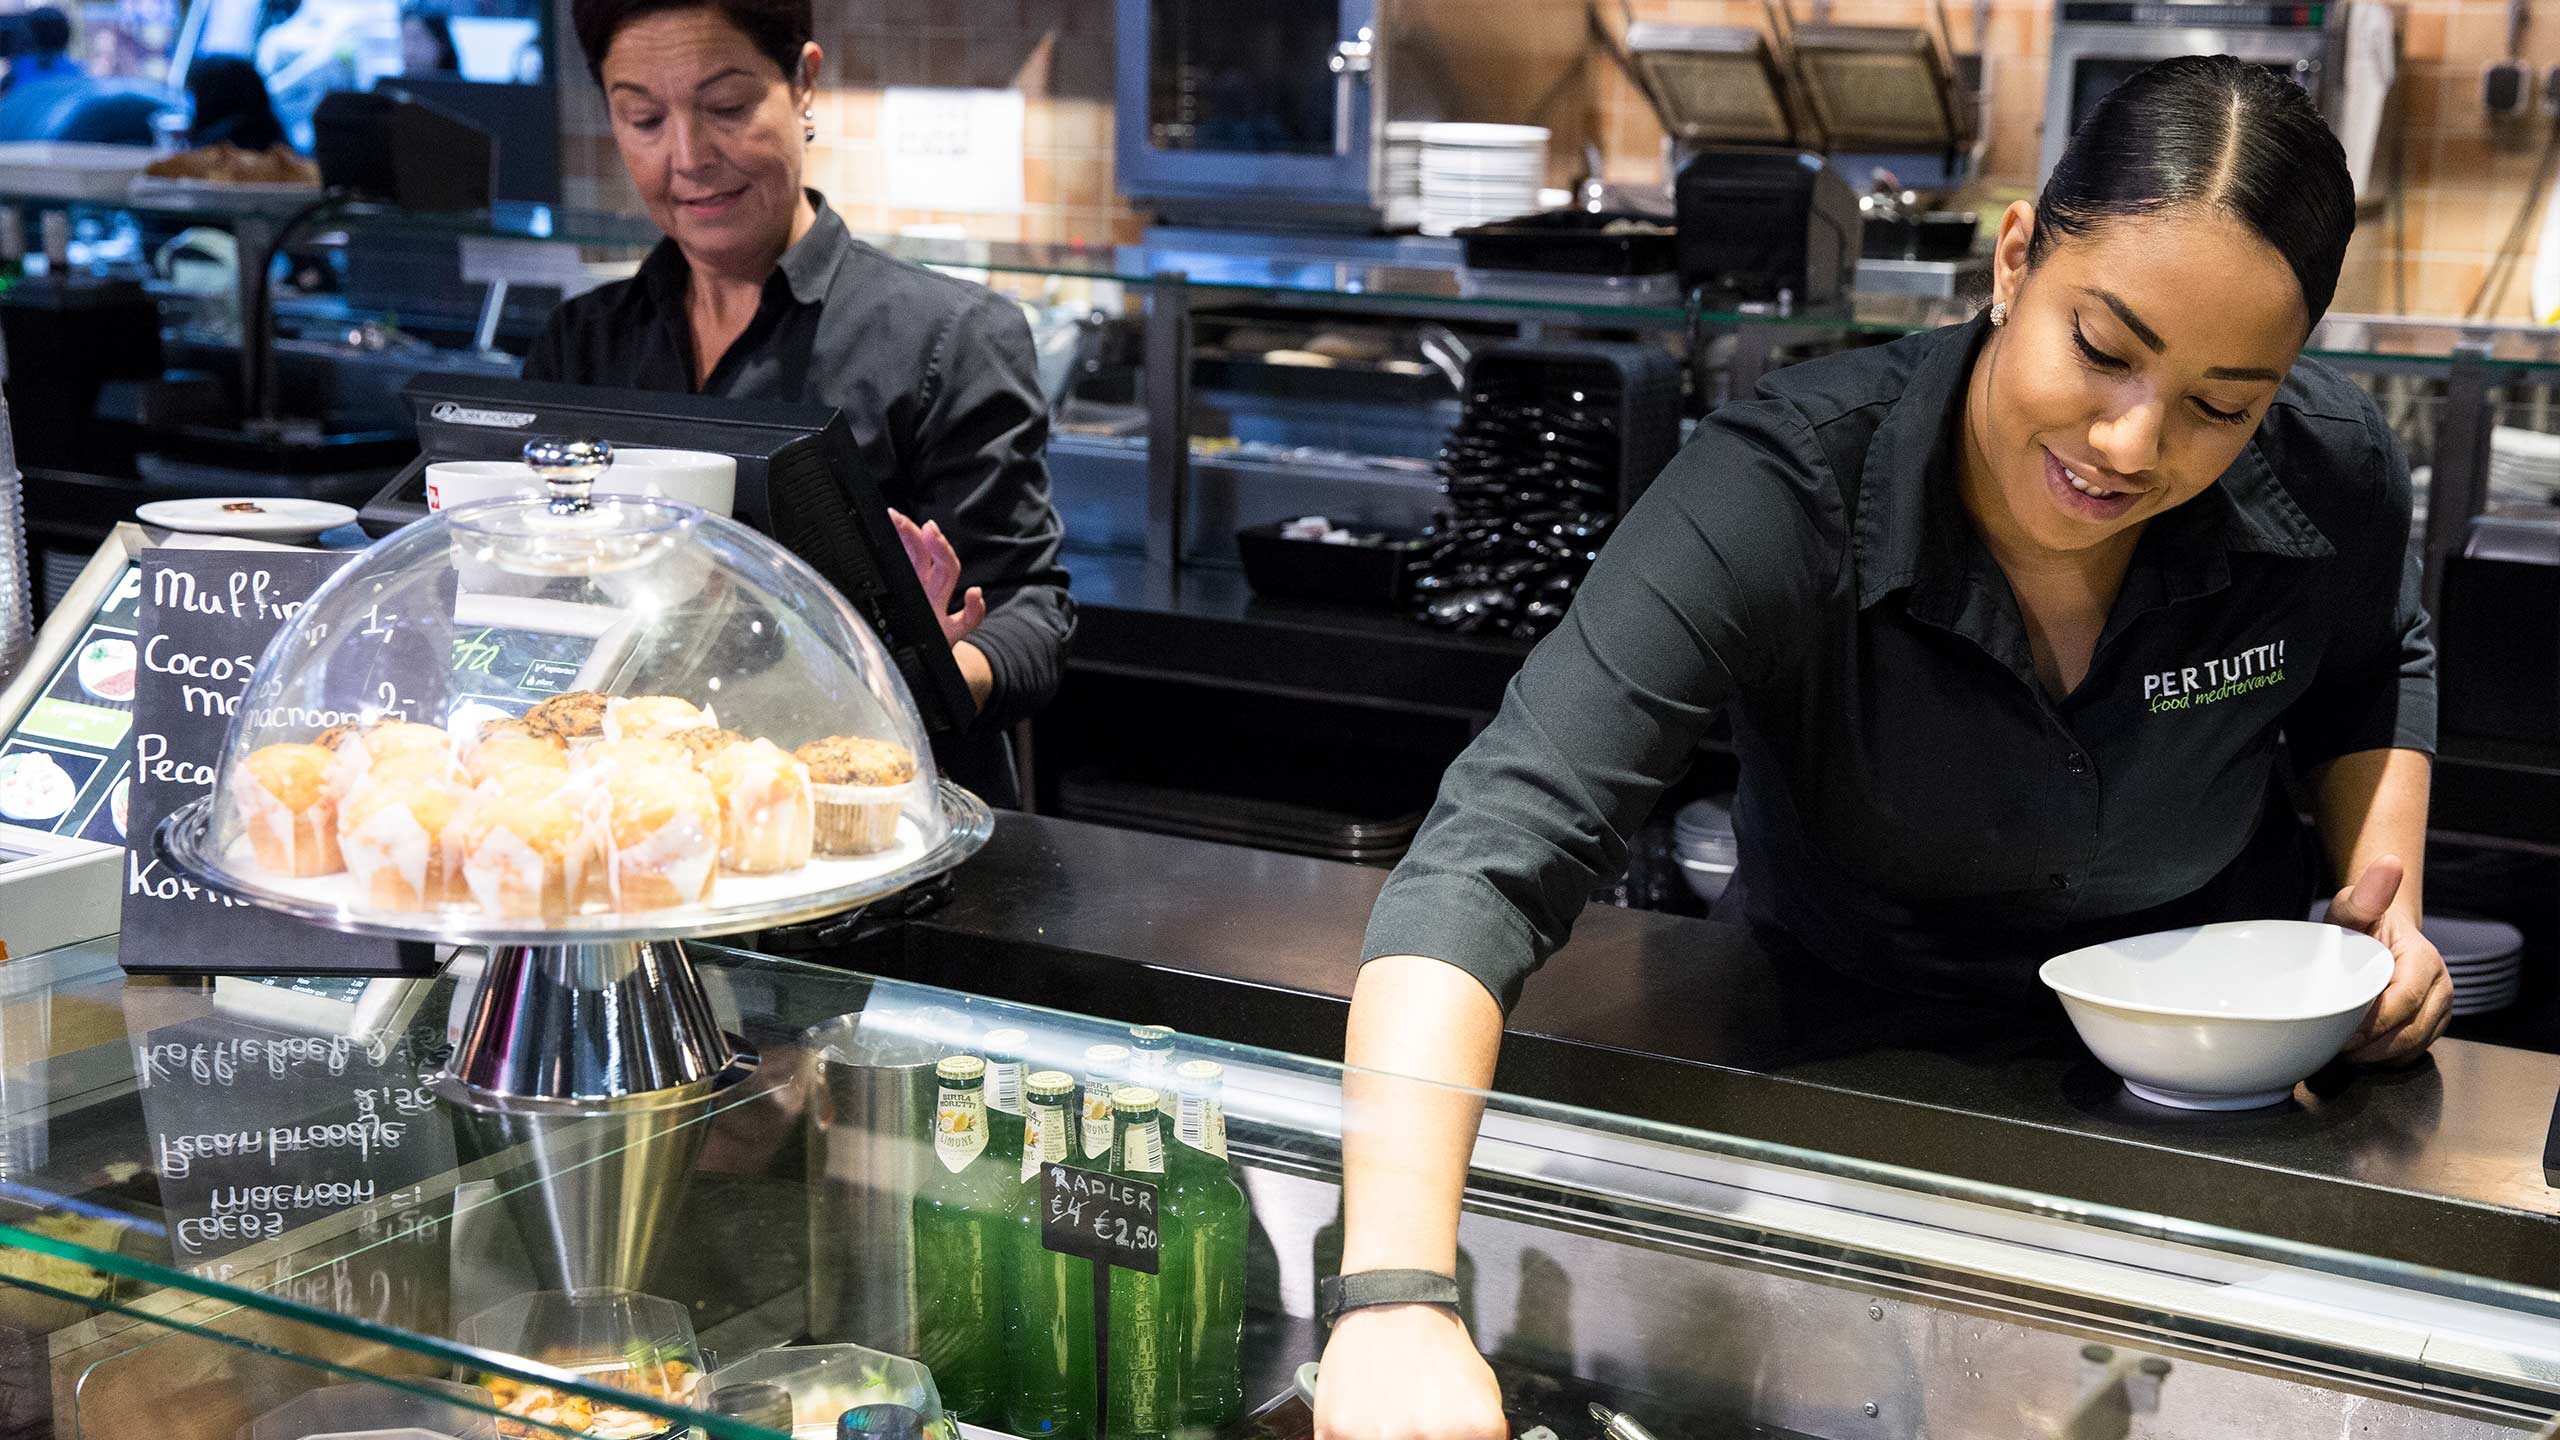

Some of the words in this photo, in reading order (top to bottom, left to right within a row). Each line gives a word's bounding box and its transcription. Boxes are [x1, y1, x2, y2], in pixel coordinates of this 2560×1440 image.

[145, 634, 256, 682] Cocos
[2144, 667, 2201, 700] PER
[2204, 640, 2284, 686] TUTTI!
[2149, 689, 2191, 713] food
[2195, 669, 2286, 704] mediterranea
[940, 1134, 974, 1148] LIMONE
[1051, 1166, 1152, 1215] RADLER
[1093, 1210, 1157, 1249] €2,50
